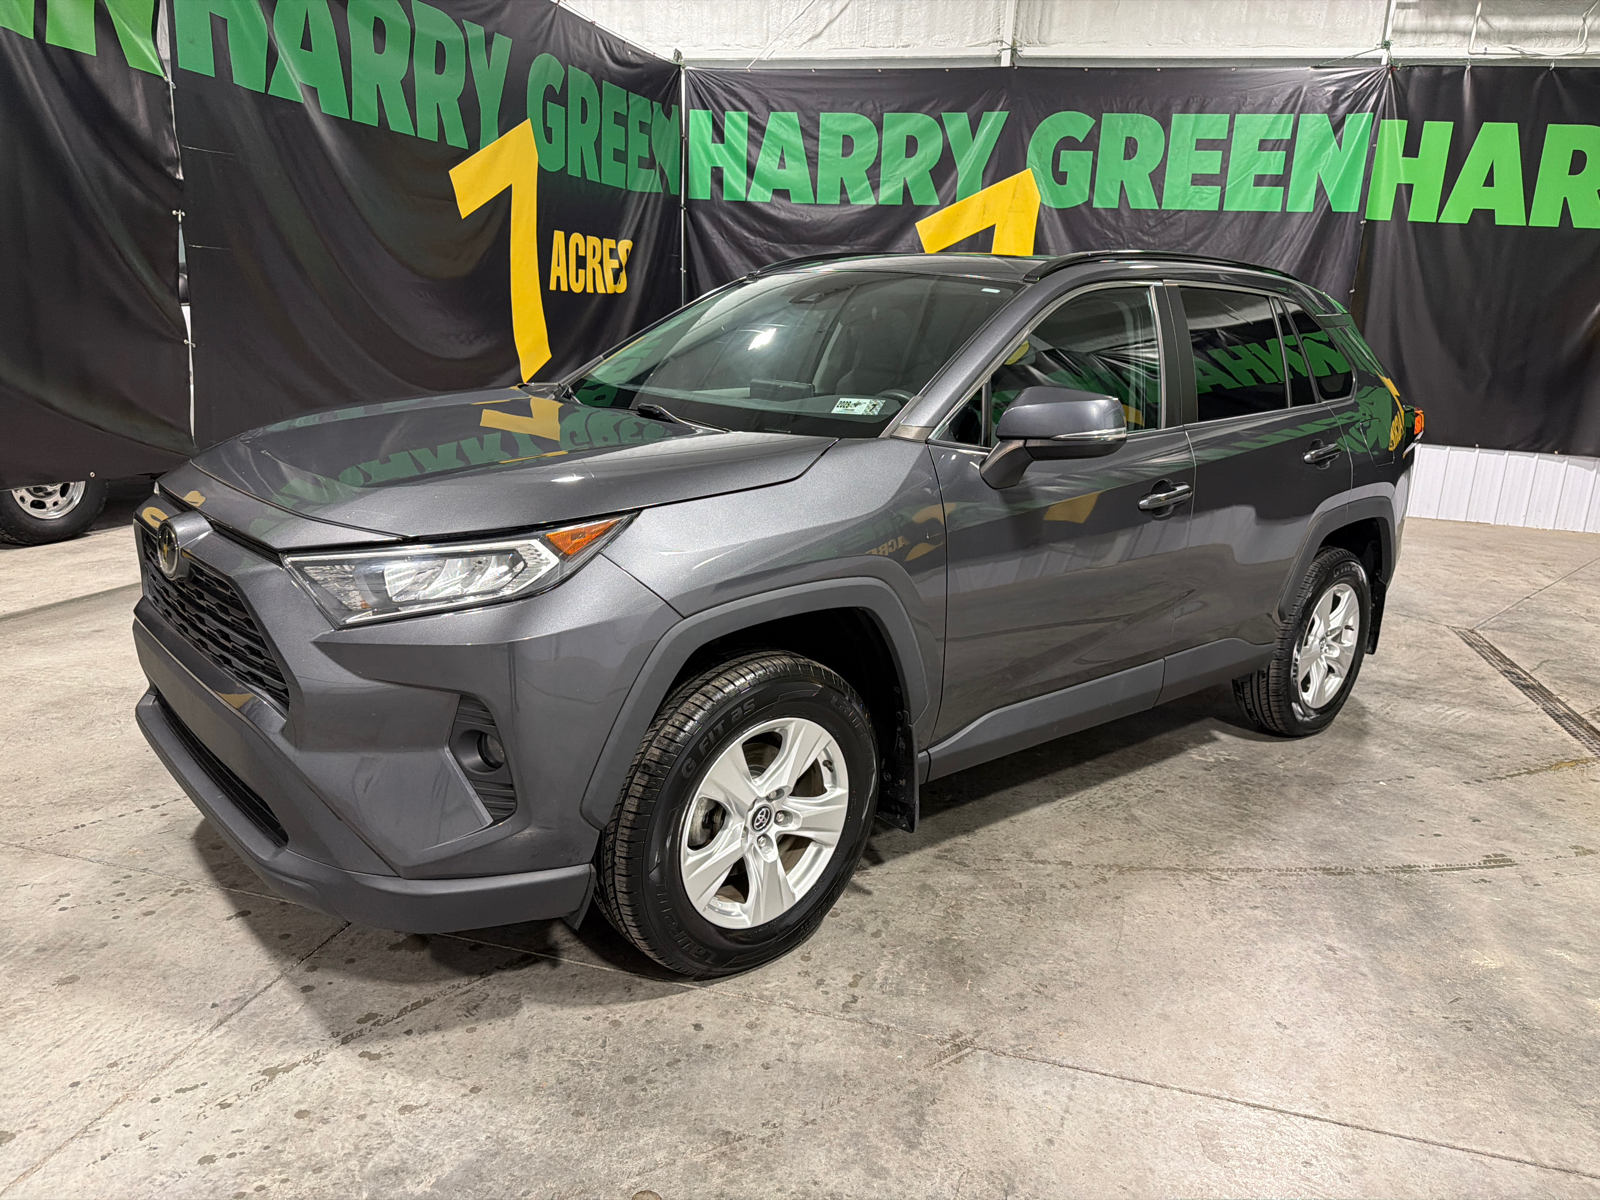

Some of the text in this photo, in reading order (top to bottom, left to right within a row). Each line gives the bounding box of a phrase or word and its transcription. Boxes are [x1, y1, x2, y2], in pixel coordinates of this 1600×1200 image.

[526, 52, 679, 196] GREEN
[688, 109, 1010, 206] HARRY
[1026, 112, 1374, 213] GREEN
[448, 118, 633, 383] 7 ACRES
[698, 719, 725, 756] FIT
